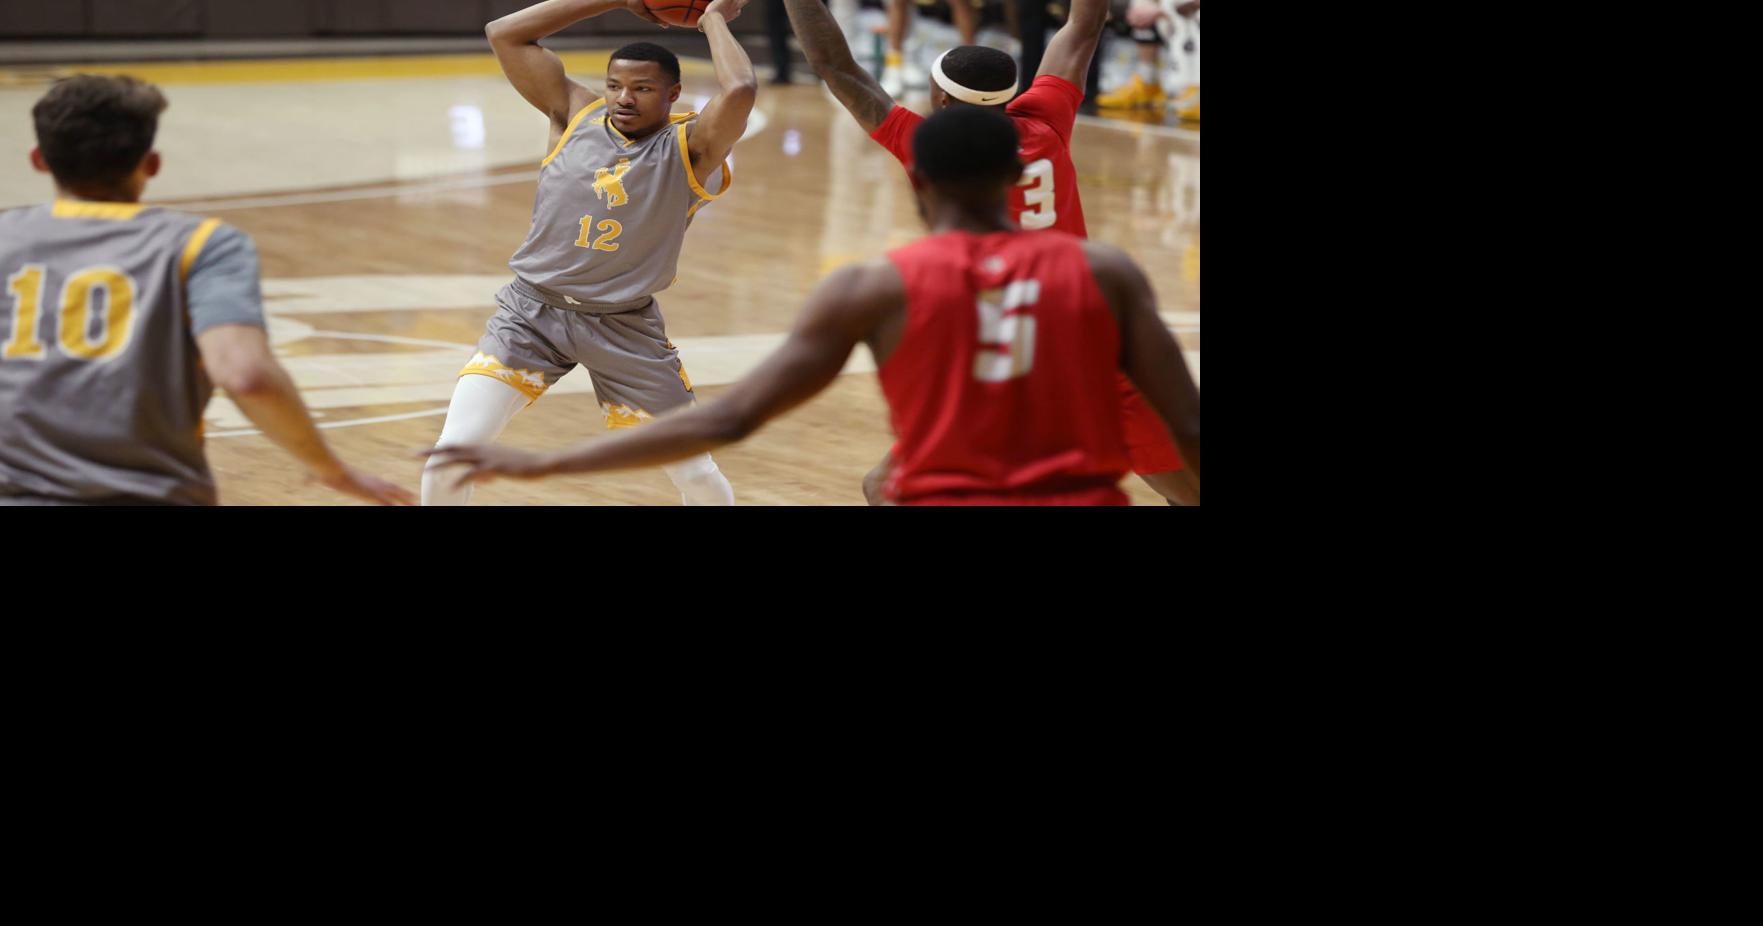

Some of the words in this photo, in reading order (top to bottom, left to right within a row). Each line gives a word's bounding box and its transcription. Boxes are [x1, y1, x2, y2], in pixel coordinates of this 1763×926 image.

[575, 214, 622, 251] 12
[1018, 158, 1057, 230] 3
[1, 264, 137, 361] 10
[973, 279, 1040, 381] 5
